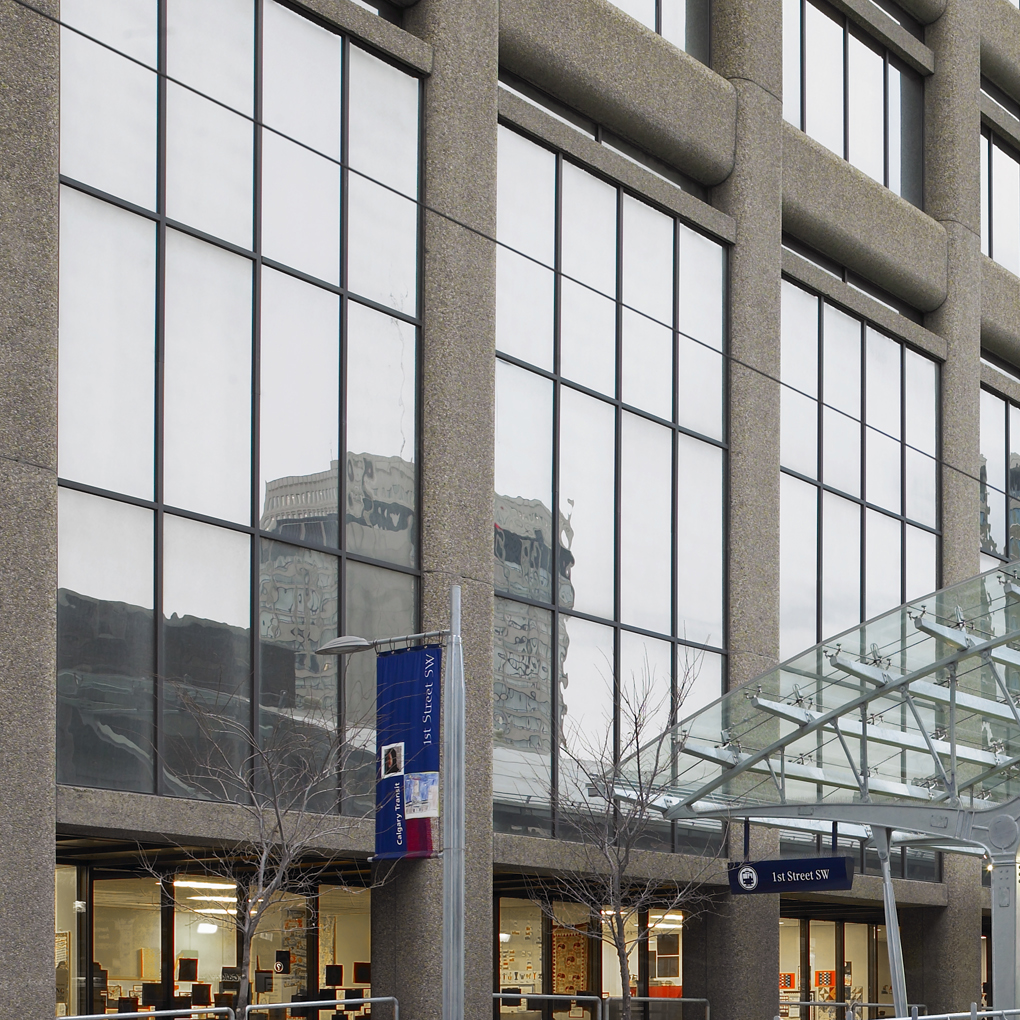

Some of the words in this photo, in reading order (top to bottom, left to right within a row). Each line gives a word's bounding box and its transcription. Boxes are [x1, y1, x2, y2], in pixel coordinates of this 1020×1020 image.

[424, 653, 435, 678] SW
[422, 682, 433, 723] Street
[423, 728, 432, 745] 1st
[396, 813, 404, 846] Calgary
[772, 872, 786, 882] 1st
[787, 870, 814, 881] Street
[815, 869, 830, 880] SW
